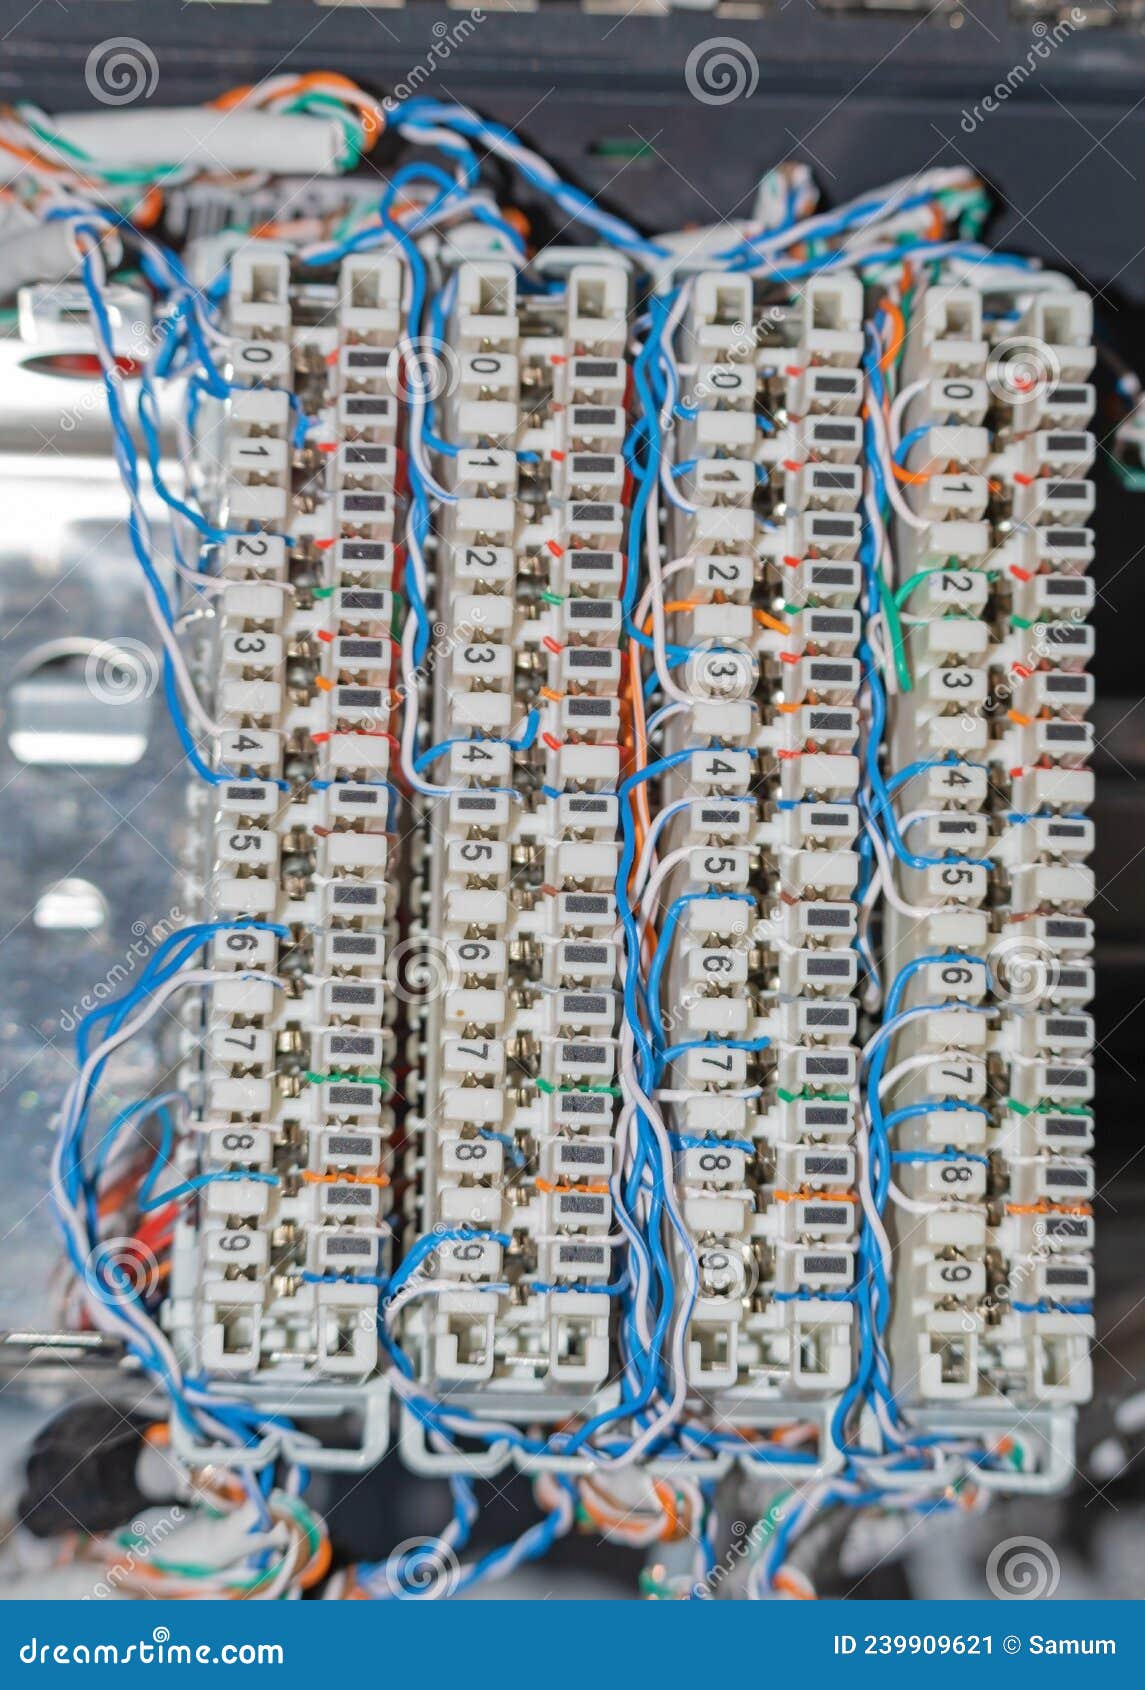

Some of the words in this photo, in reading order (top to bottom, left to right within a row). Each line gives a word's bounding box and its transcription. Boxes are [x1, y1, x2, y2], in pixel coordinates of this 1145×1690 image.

[243, 347, 273, 363] 0
[470, 358, 501, 373] 0
[711, 373, 742, 389] 0
[943, 384, 973, 399] 0
[239, 445, 270, 457] 1
[468, 456, 500, 468] 1
[942, 482, 974, 493] 1
[236, 539, 268, 556] 2
[466, 550, 497, 566] 2
[709, 564, 739, 580] 2
[943, 575, 973, 591] 2
[234, 638, 265, 653] 3
[464, 648, 495, 663] 3
[708, 662, 737, 677] 3
[942, 673, 973, 688] 3
[232, 735, 262, 752] 4
[462, 745, 493, 762] 4
[706, 759, 736, 775] 4
[943, 770, 971, 787] 4
[230, 835, 261, 851] 5
[461, 845, 492, 861] 5
[704, 857, 735, 873] 5
[942, 869, 972, 885] 5
[226, 934, 258, 951] 6
[458, 944, 490, 960] 6
[703, 956, 733, 972] 6
[942, 967, 972, 984] 6
[224, 1035, 256, 1051] 7
[457, 1044, 488, 1060] 7
[702, 1055, 732, 1071] 7
[942, 1067, 972, 1083] 7
[222, 1134, 254, 1151] 8
[455, 1144, 487, 1160] 8
[699, 1154, 731, 1171] 8
[941, 1167, 972, 1183] 8
[219, 1235, 250, 1251] 9
[453, 1244, 484, 1261] 9
[698, 1252, 730, 1270] 9
[941, 1266, 971, 1282] 9
